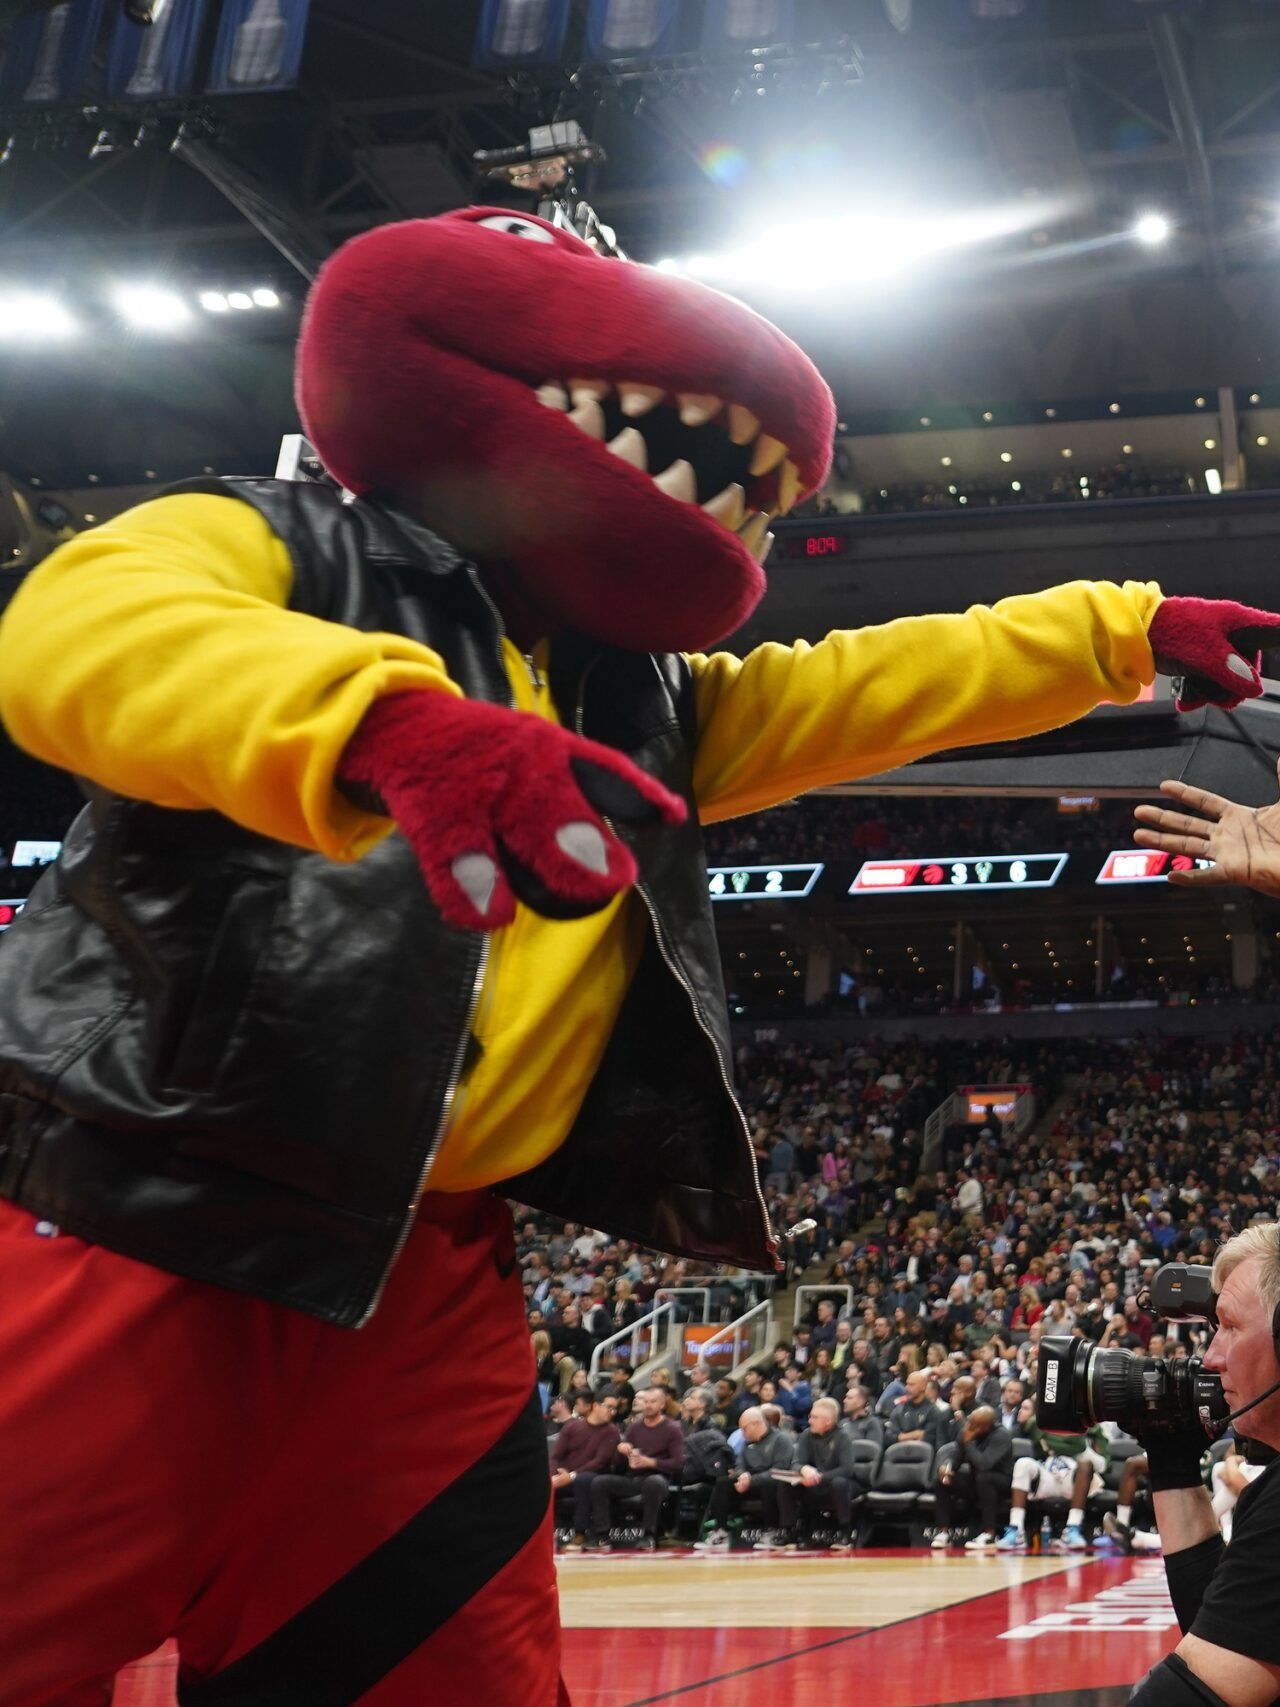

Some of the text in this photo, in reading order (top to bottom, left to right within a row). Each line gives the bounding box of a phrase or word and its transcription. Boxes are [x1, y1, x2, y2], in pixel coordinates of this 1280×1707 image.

[765, 870, 783, 892] 2
[950, 860, 1027, 885] 3 6
[1046, 1362, 1058, 1401] CAM B
